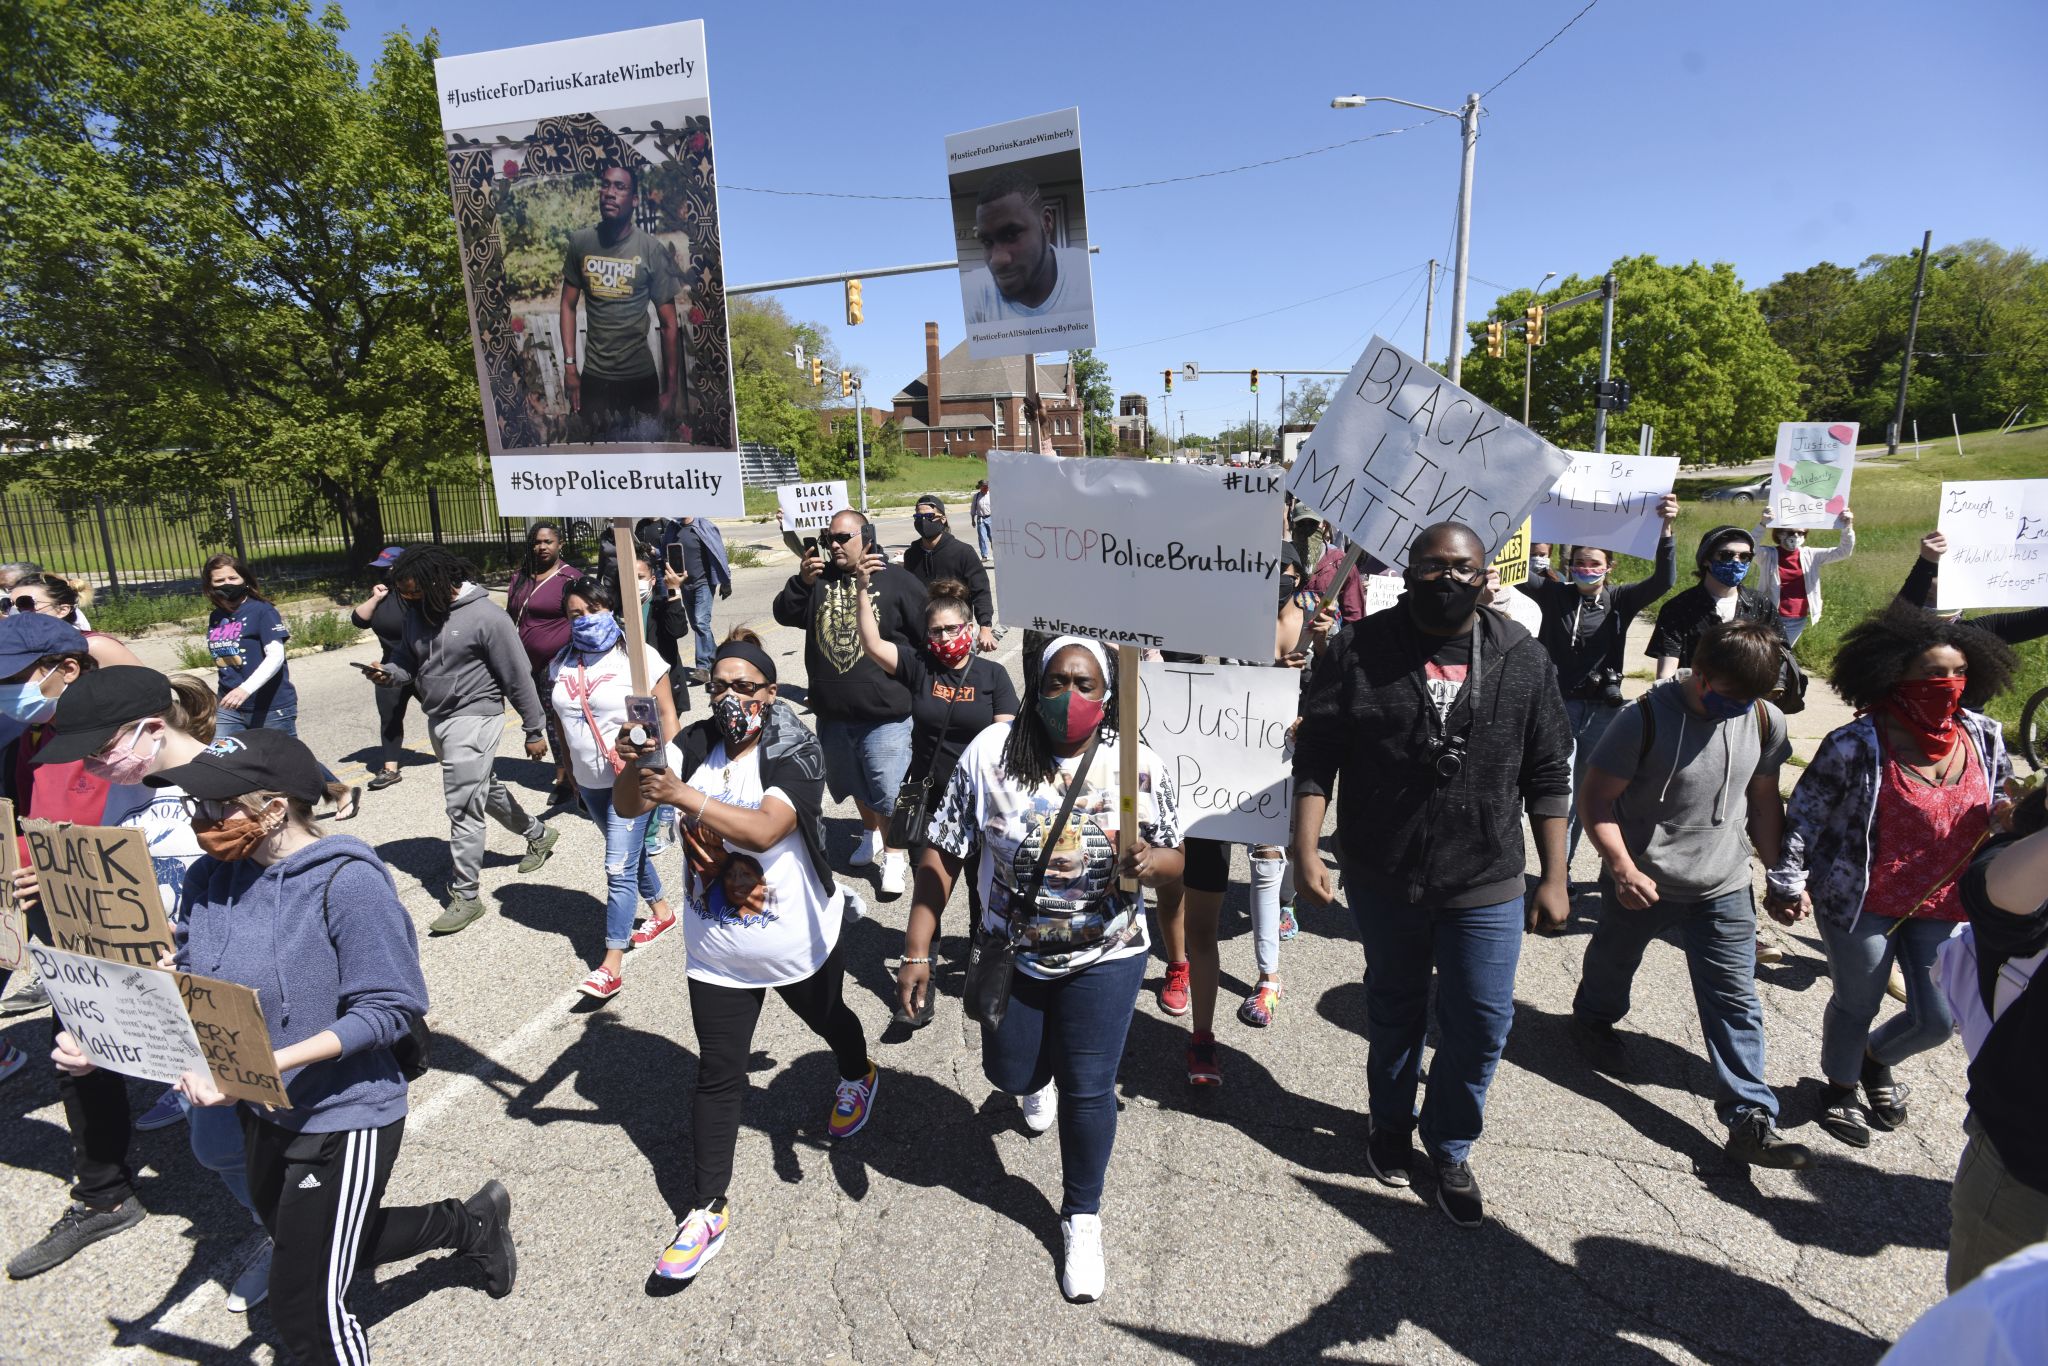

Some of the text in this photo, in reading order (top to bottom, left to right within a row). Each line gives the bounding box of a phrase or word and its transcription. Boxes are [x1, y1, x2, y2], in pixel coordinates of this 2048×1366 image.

[447, 56, 695, 108] #JusticeForDariusKarateWimberly
[950, 128, 1074, 162] #JusticeForDariusKarateWimberly
[972, 322, 1089, 343] #JusticeForAllStolenLivesByPolice
[1356, 347, 1500, 470] BLACK
[1793, 437, 1840, 451] Justice
[510, 468, 722, 497] #StopPoliceBrutality
[1222, 471, 1279, 494] #LLK
[1567, 464, 1592, 474] N'T
[1789, 470, 1833, 488] Solidarity
[795, 485, 832, 498] BLACK
[799, 500, 833, 513] LIVES
[1947, 490, 1996, 518] Enough
[795, 515, 834, 528] MATTE
[1293, 449, 1424, 568] MATTE
[1780, 497, 1823, 518] Peace
[996, 518, 1278, 580] #STOPPoliceBrutality
[1032, 616, 1167, 647] #WEAREKARATE
[1175, 754, 1288, 819] Peace!
[29, 831, 140, 885] BLACK
[47, 879, 150, 933] LIVES
[31, 949, 109, 987] Black
[47, 988, 105, 1023] Lives
[180, 974, 216, 1014] for
[67, 1022, 142, 1063] Matter
[235, 1068, 280, 1093] LOST
